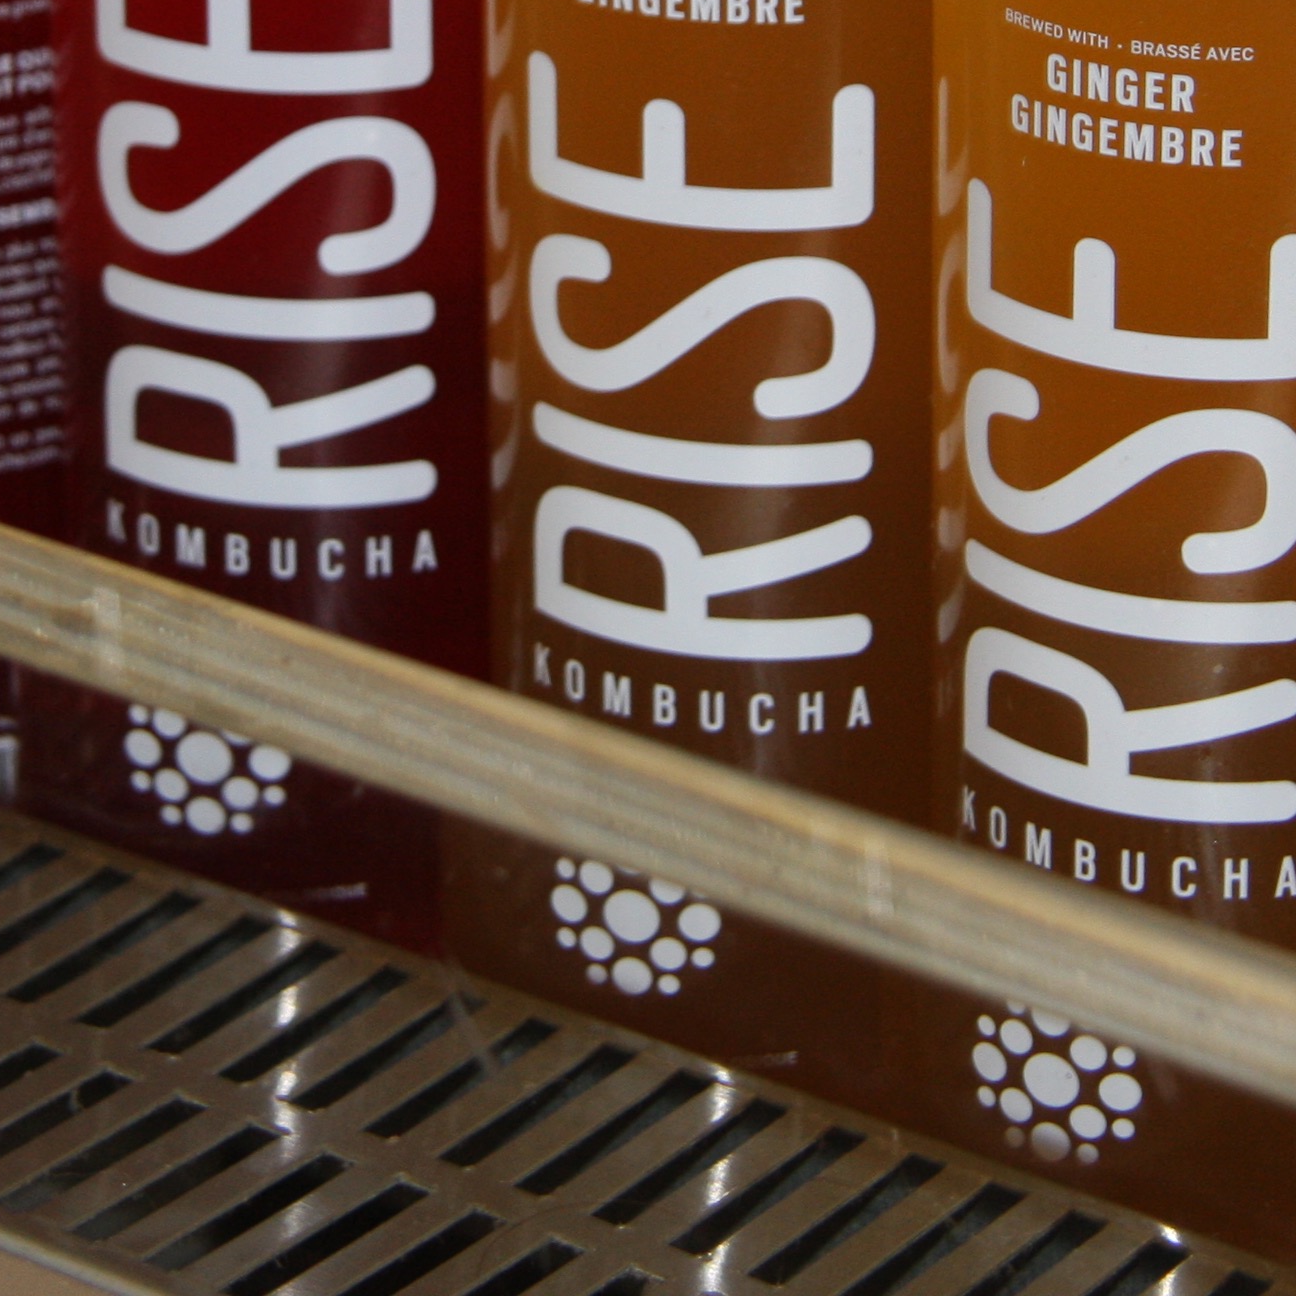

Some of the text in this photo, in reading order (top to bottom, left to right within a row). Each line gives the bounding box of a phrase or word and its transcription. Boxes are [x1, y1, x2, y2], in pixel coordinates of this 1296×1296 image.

[1005, 7, 1254, 62] BREWED WITH BRASSÉ AVEC
[1046, 53, 1196, 113] GINGER
[1010, 93, 1243, 167] GINGEMBRE
[527, 50, 876, 661] RISE
[106, 499, 438, 580] KOMBUCHA
[533, 642, 872, 734] KOMBUCHA
